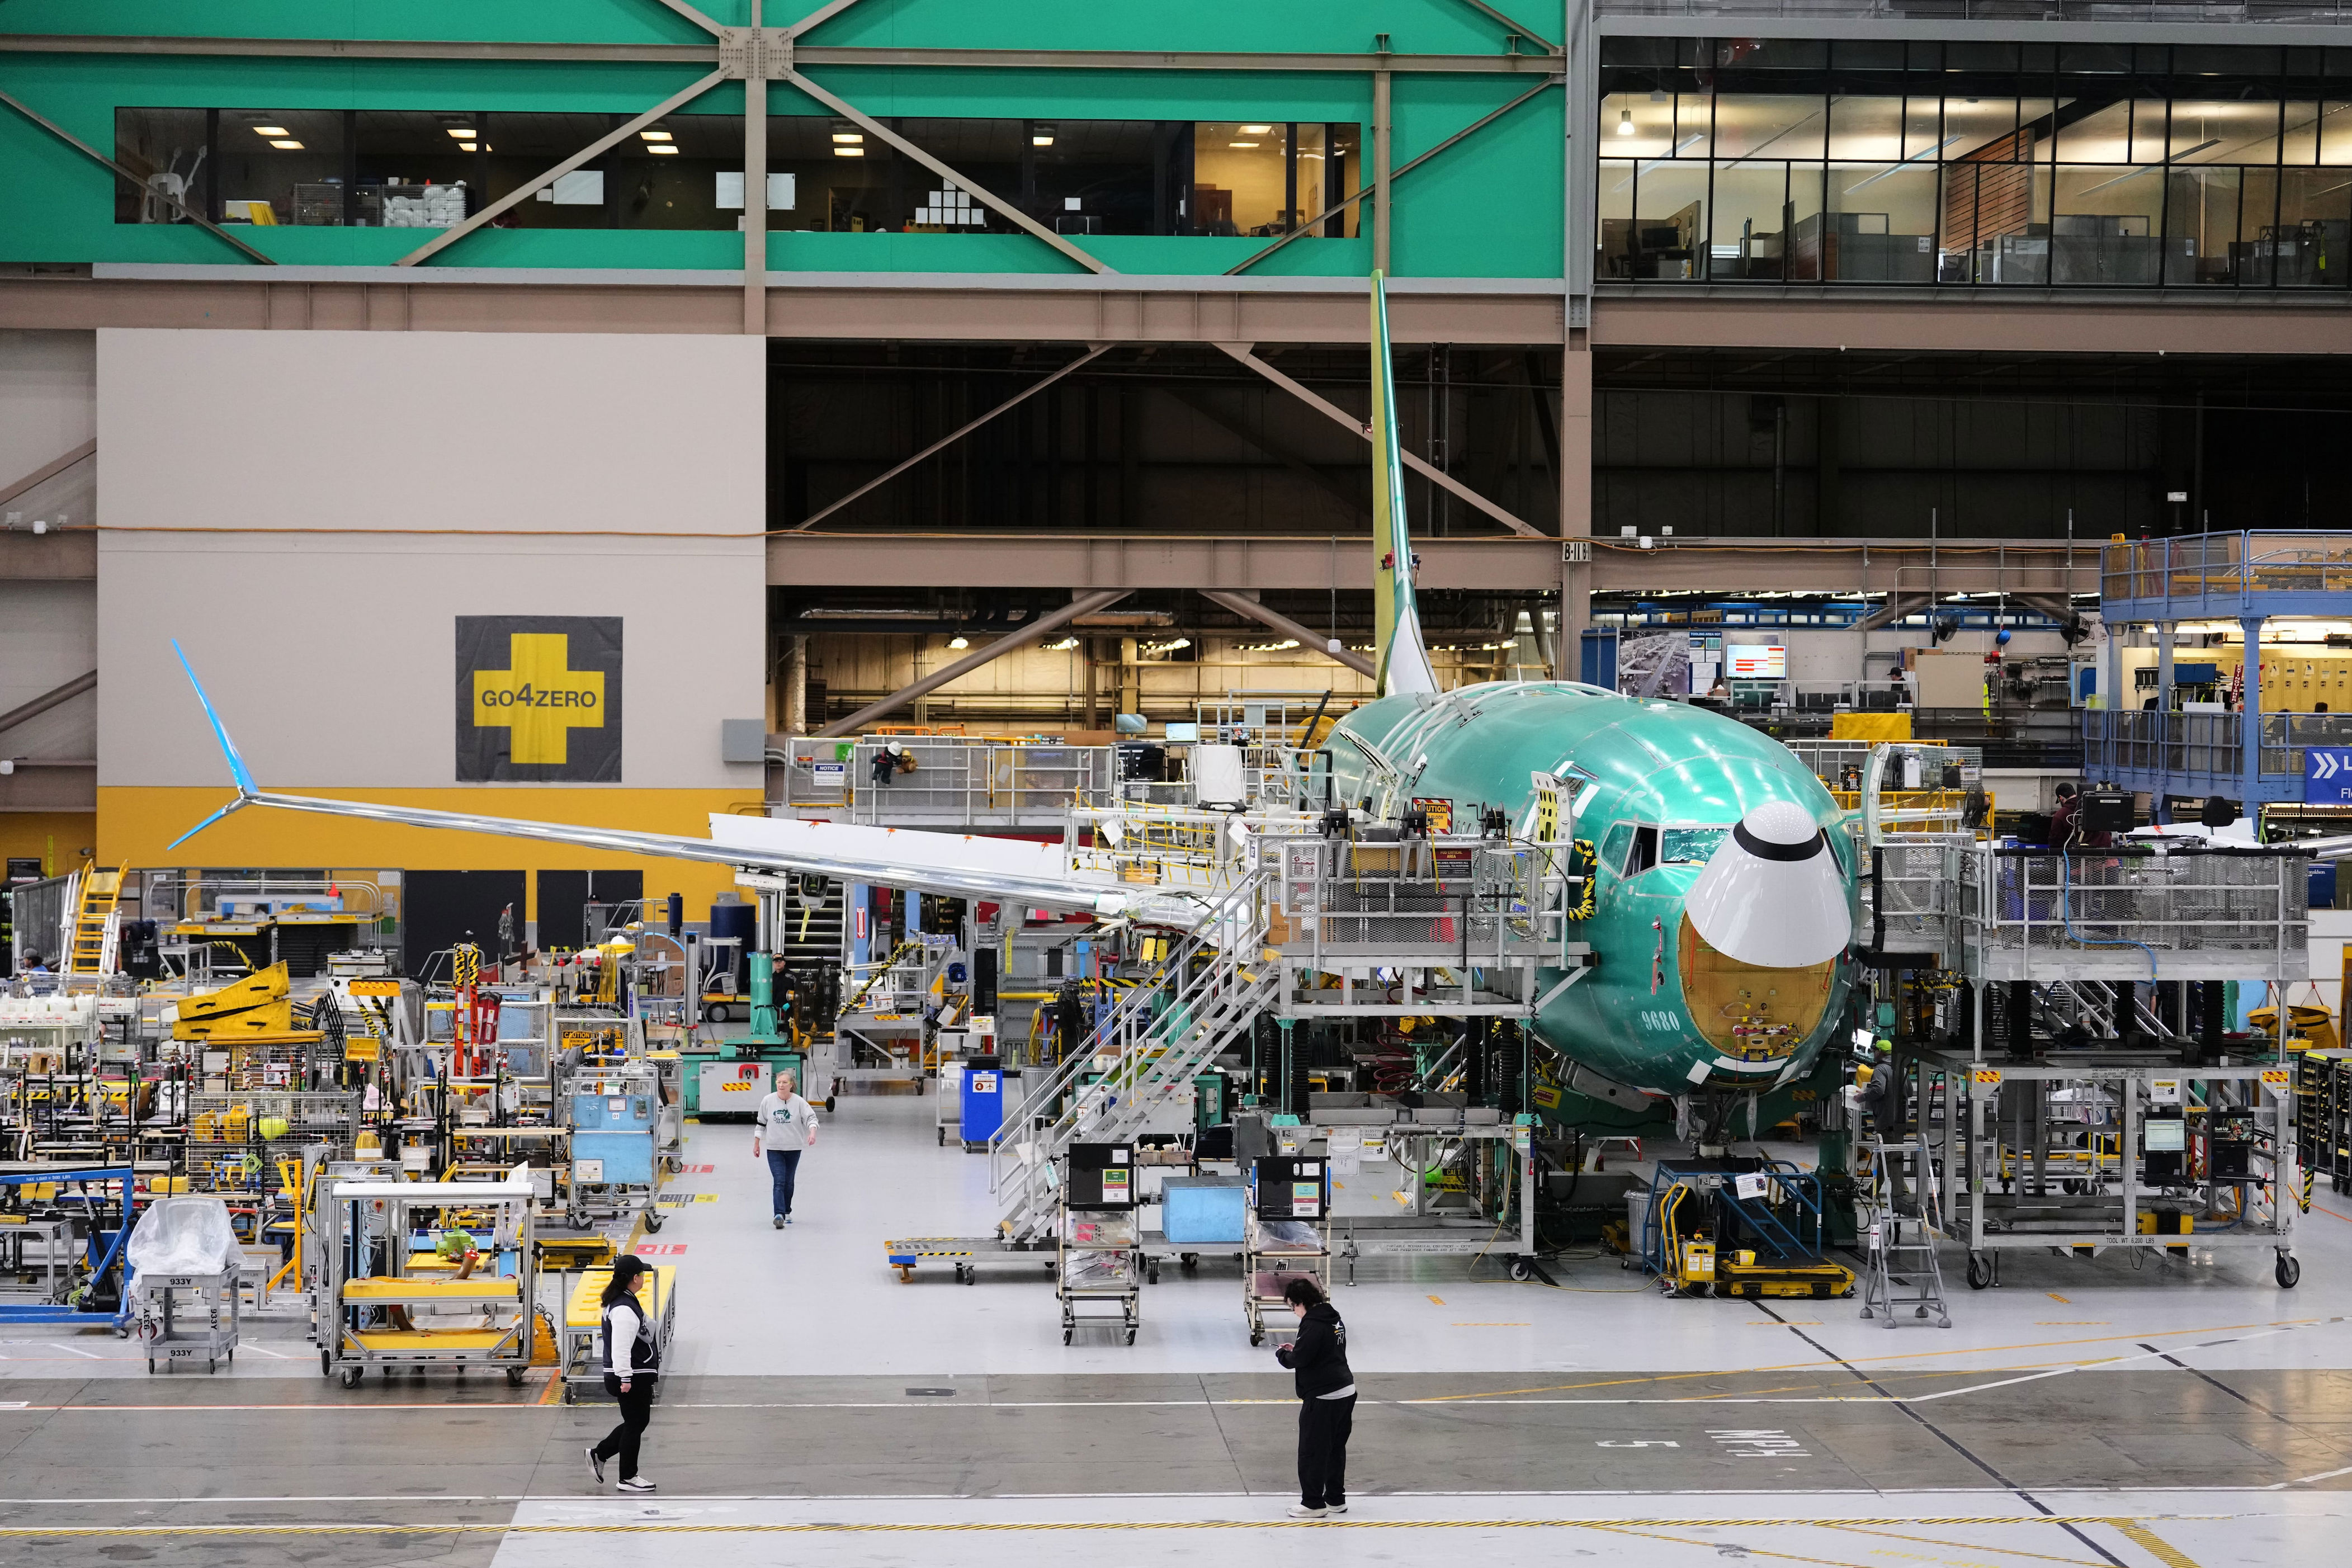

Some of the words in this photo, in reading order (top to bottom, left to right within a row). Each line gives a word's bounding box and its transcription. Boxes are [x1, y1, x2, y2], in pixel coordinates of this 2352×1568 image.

[481, 683, 596, 707] GO4ZERO
[2231, 665, 2242, 702] EXTINGUISHER
[1418, 804, 1447, 813] CUTION
[1641, 1010, 1680, 1031] 9680
[1704, 1429, 1812, 1457] MPH
